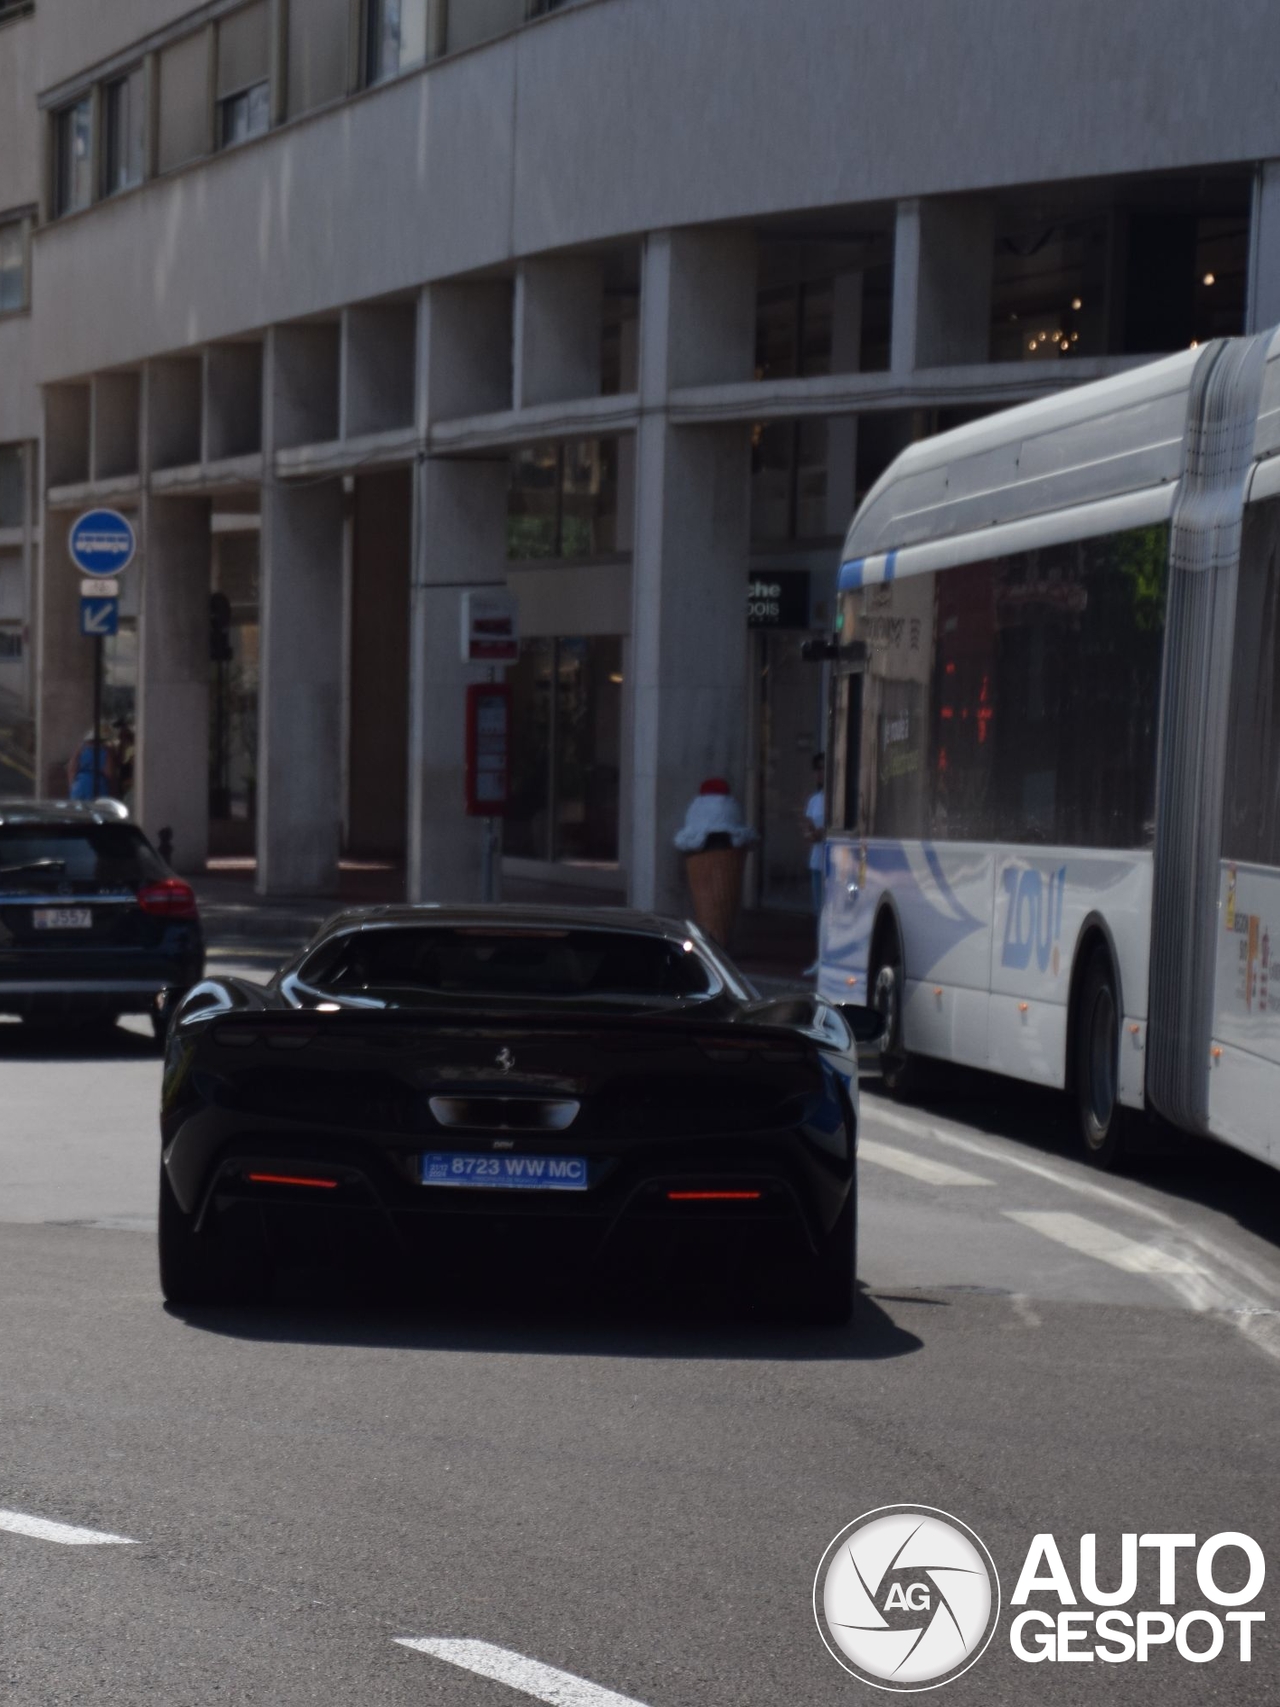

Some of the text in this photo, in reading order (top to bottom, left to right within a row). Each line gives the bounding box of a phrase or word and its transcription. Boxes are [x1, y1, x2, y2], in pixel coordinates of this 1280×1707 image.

[1001, 864, 1067, 977] ZOU!
[451, 1157, 582, 1178] 8723 WW MC
